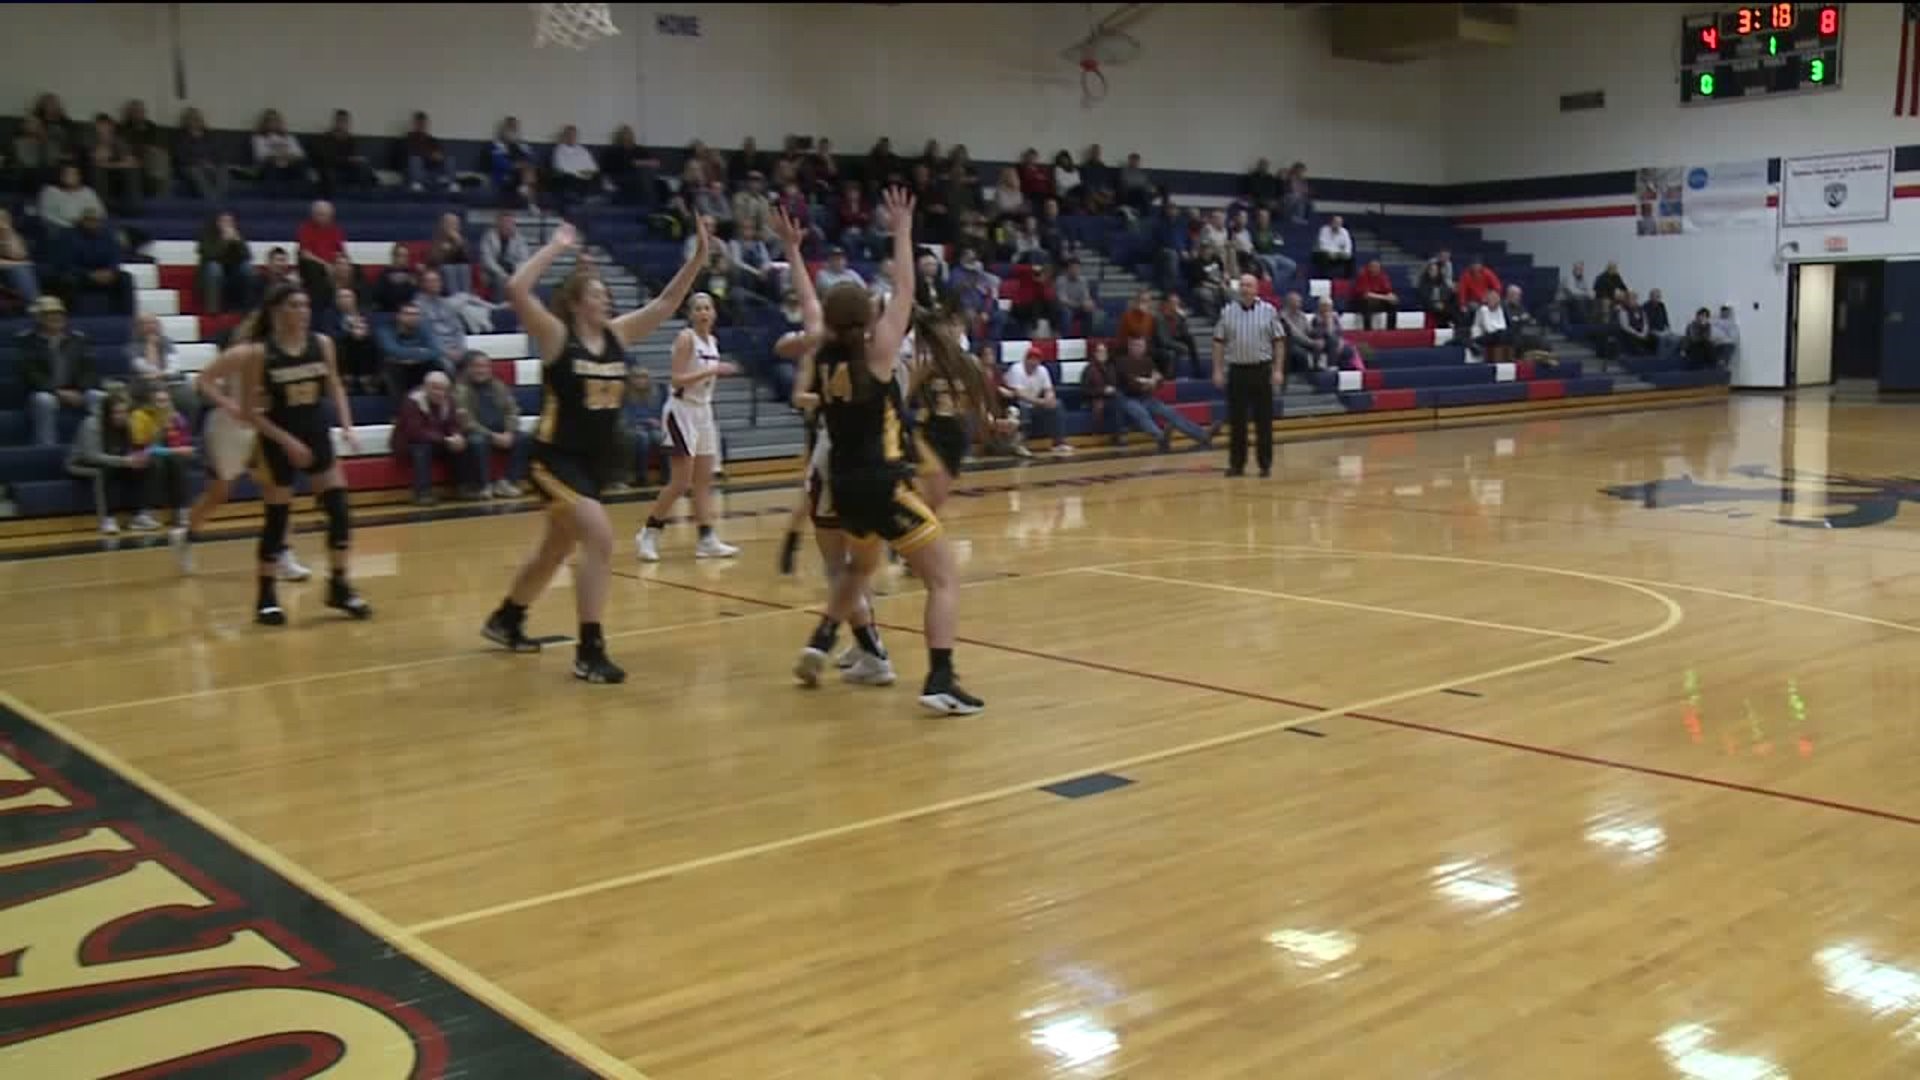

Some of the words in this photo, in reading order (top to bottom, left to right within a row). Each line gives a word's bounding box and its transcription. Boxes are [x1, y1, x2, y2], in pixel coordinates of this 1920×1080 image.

[1736, 3, 1792, 35] 3:18
[1819, 8, 1837, 35] 8
[1701, 27, 1718, 50] 4
[1768, 35, 1778, 57] 1
[1809, 58, 1825, 83] 3
[1699, 73, 1714, 96] 0
[818, 361, 853, 404] 14
